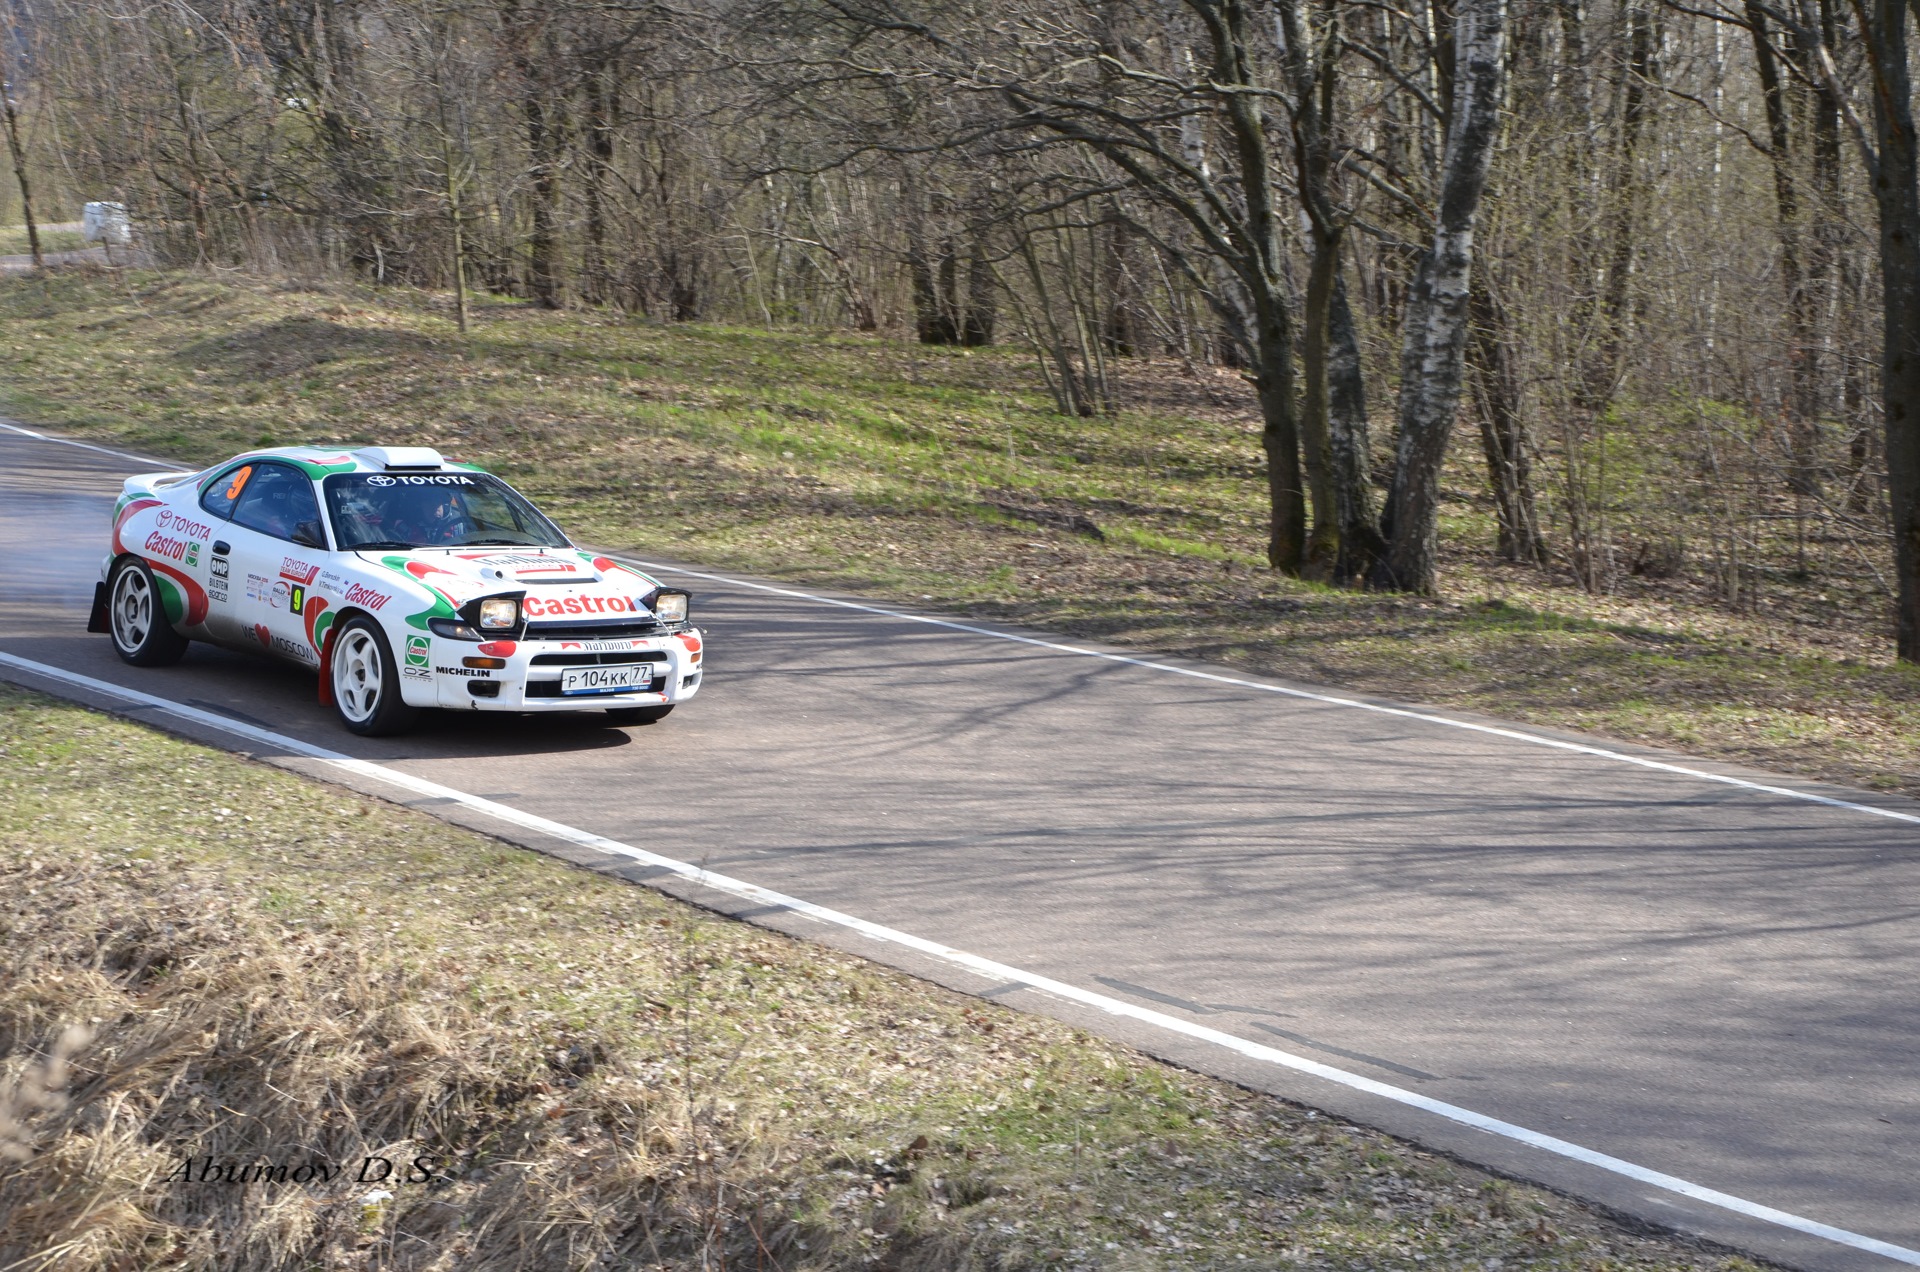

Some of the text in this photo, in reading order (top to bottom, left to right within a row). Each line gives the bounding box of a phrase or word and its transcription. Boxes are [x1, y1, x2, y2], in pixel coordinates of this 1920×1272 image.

[226, 466, 252, 500] 9
[397, 476, 475, 485] TOYOTA
[171, 515, 212, 541] TOYOTA
[144, 530, 188, 561] Castrol
[283, 556, 309, 573] TOYOTA
[208, 577, 229, 591] BILSTEIN
[208, 588, 228, 602] sparco
[293, 588, 302, 611] 9
[344, 582, 393, 611] Castrol
[523, 594, 637, 616] Castrol
[270, 634, 314, 661] MOSCOW
[409, 646, 428, 656] Castrol
[436, 666, 490, 677] MICHELIN
[632, 667, 648, 679] 77
